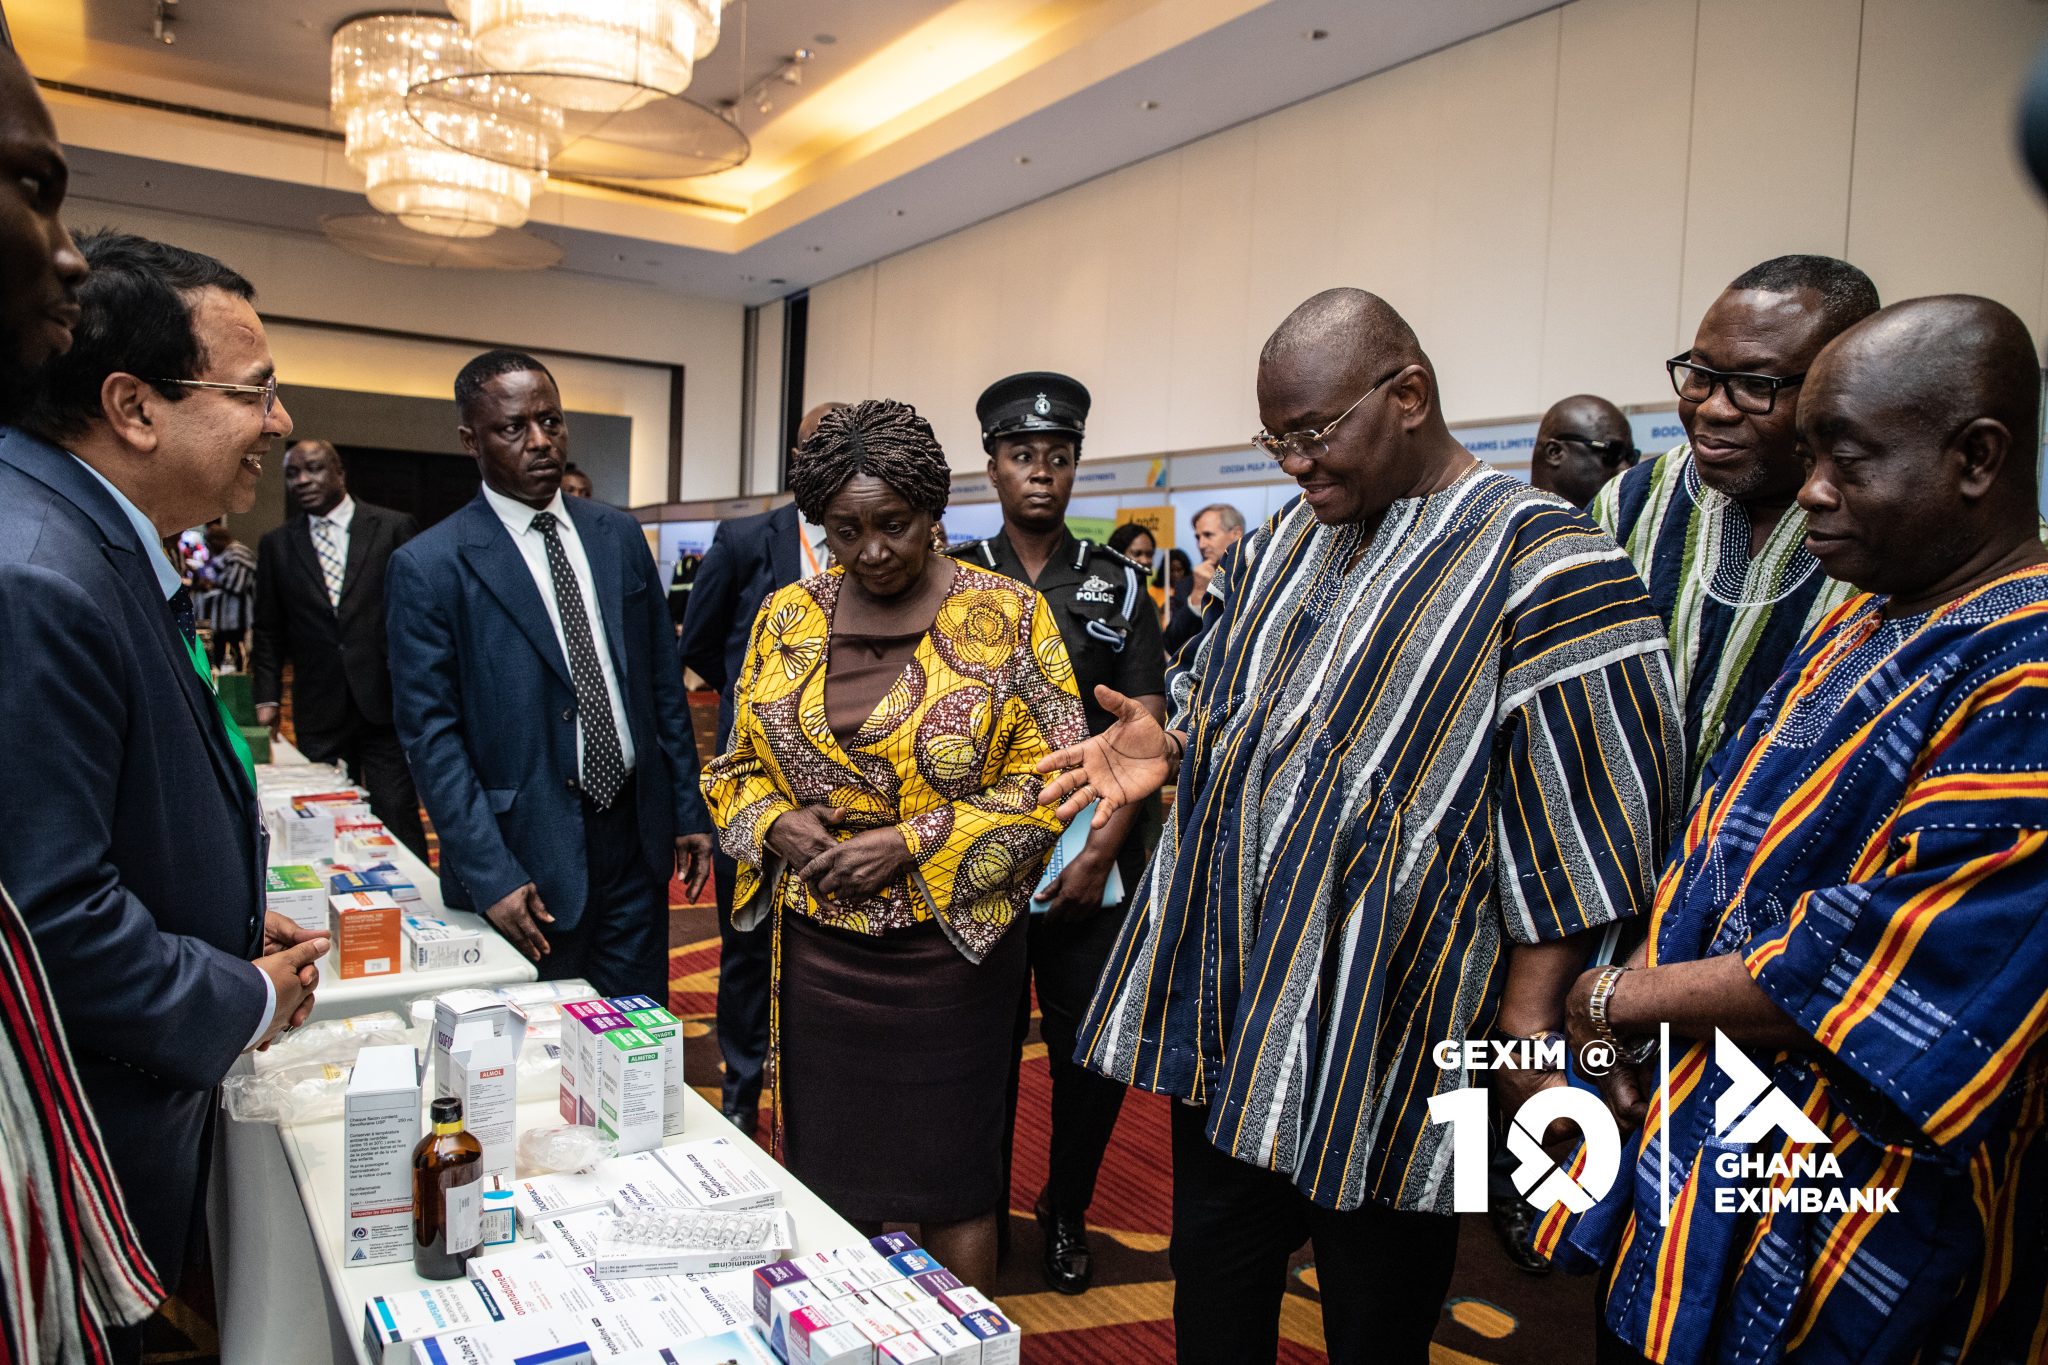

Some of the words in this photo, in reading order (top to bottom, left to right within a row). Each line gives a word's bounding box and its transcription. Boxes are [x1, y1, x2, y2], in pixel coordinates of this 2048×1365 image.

[1500, 436, 1537, 451] LIMITE
[1076, 592, 1115, 605] POLICE
[630, 1053, 656, 1063] ALMETRO
[481, 1068, 503, 1079] ALMOL
[558, 1227, 587, 1259] Artemether
[703, 1293, 737, 1327] Diazepam
[596, 1327, 621, 1356] Pethidine
[459, 1343, 476, 1360] Zone
